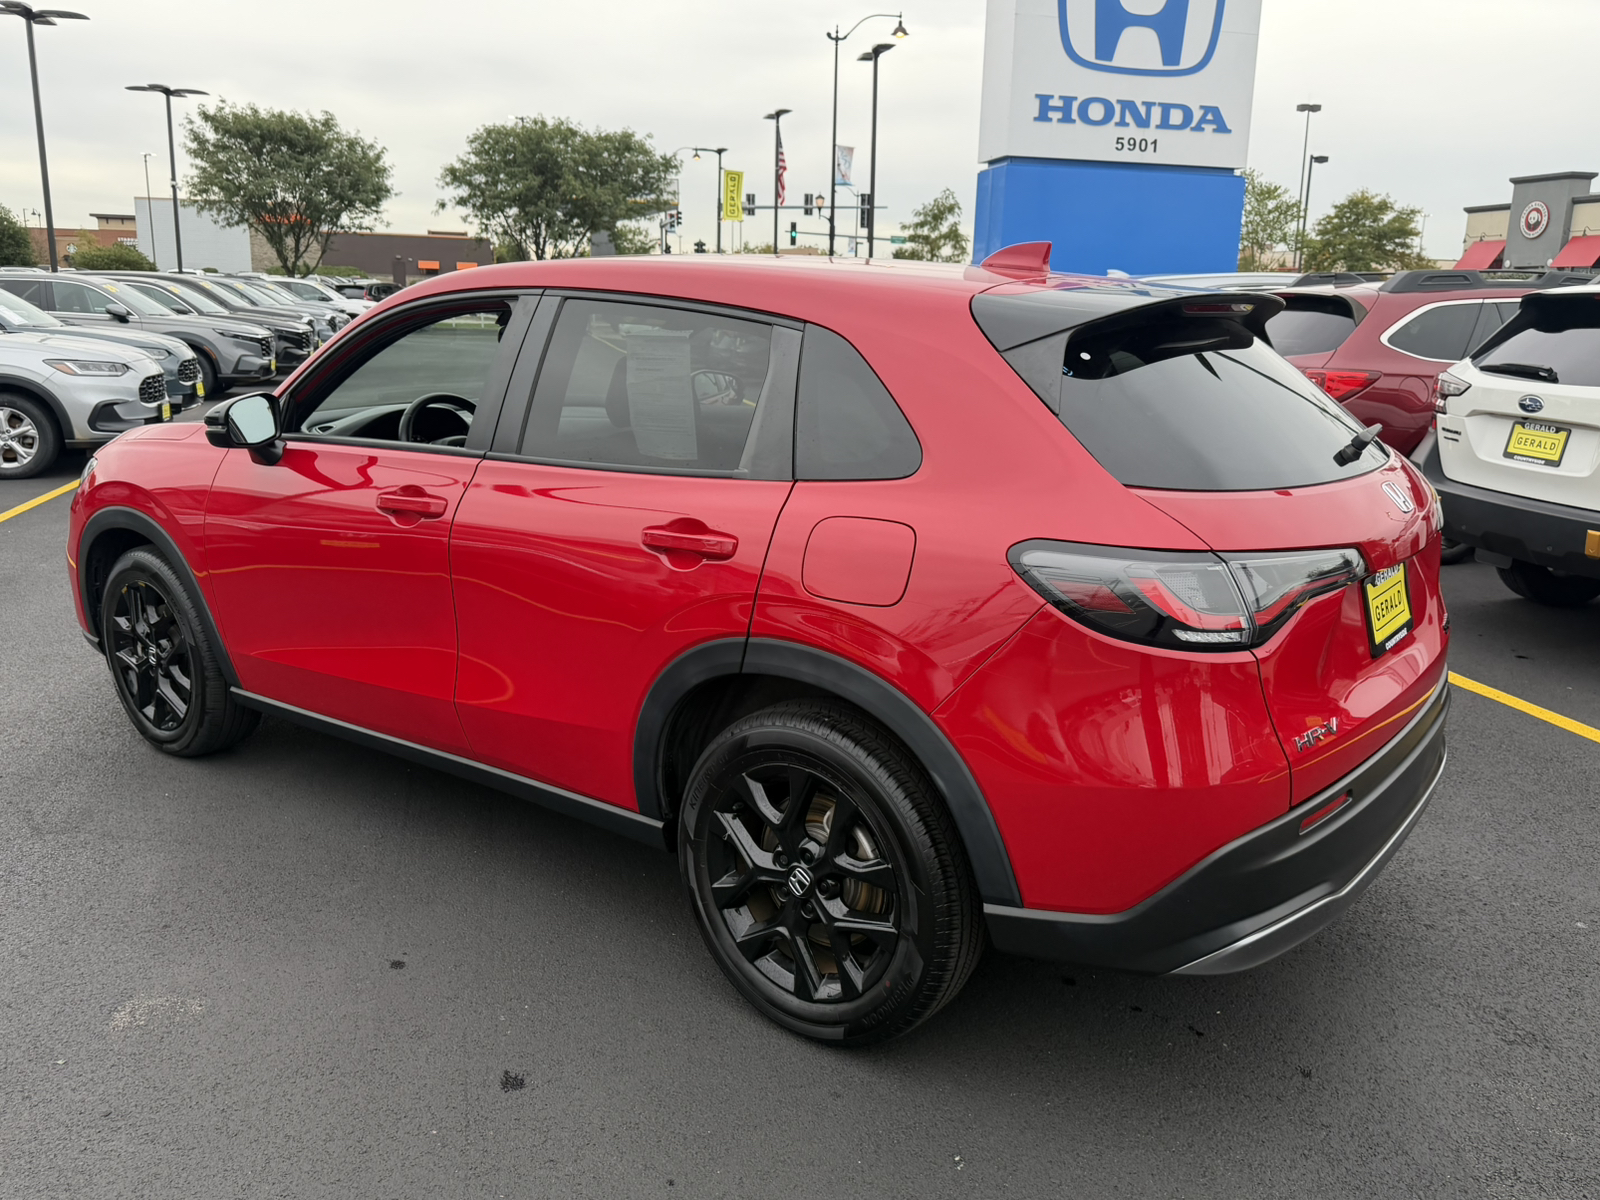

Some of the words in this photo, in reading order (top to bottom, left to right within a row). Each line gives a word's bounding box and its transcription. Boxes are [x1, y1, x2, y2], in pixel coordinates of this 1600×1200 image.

[1033, 93, 1232, 134] HONDA
[1114, 136, 1158, 153] 5901
[1524, 423, 1556, 433] GERALD
[1516, 436, 1557, 451] GERALD
[1375, 564, 1401, 585] GERALD
[1375, 590, 1402, 622] GERALD
[1292, 716, 1339, 753] HR-V
